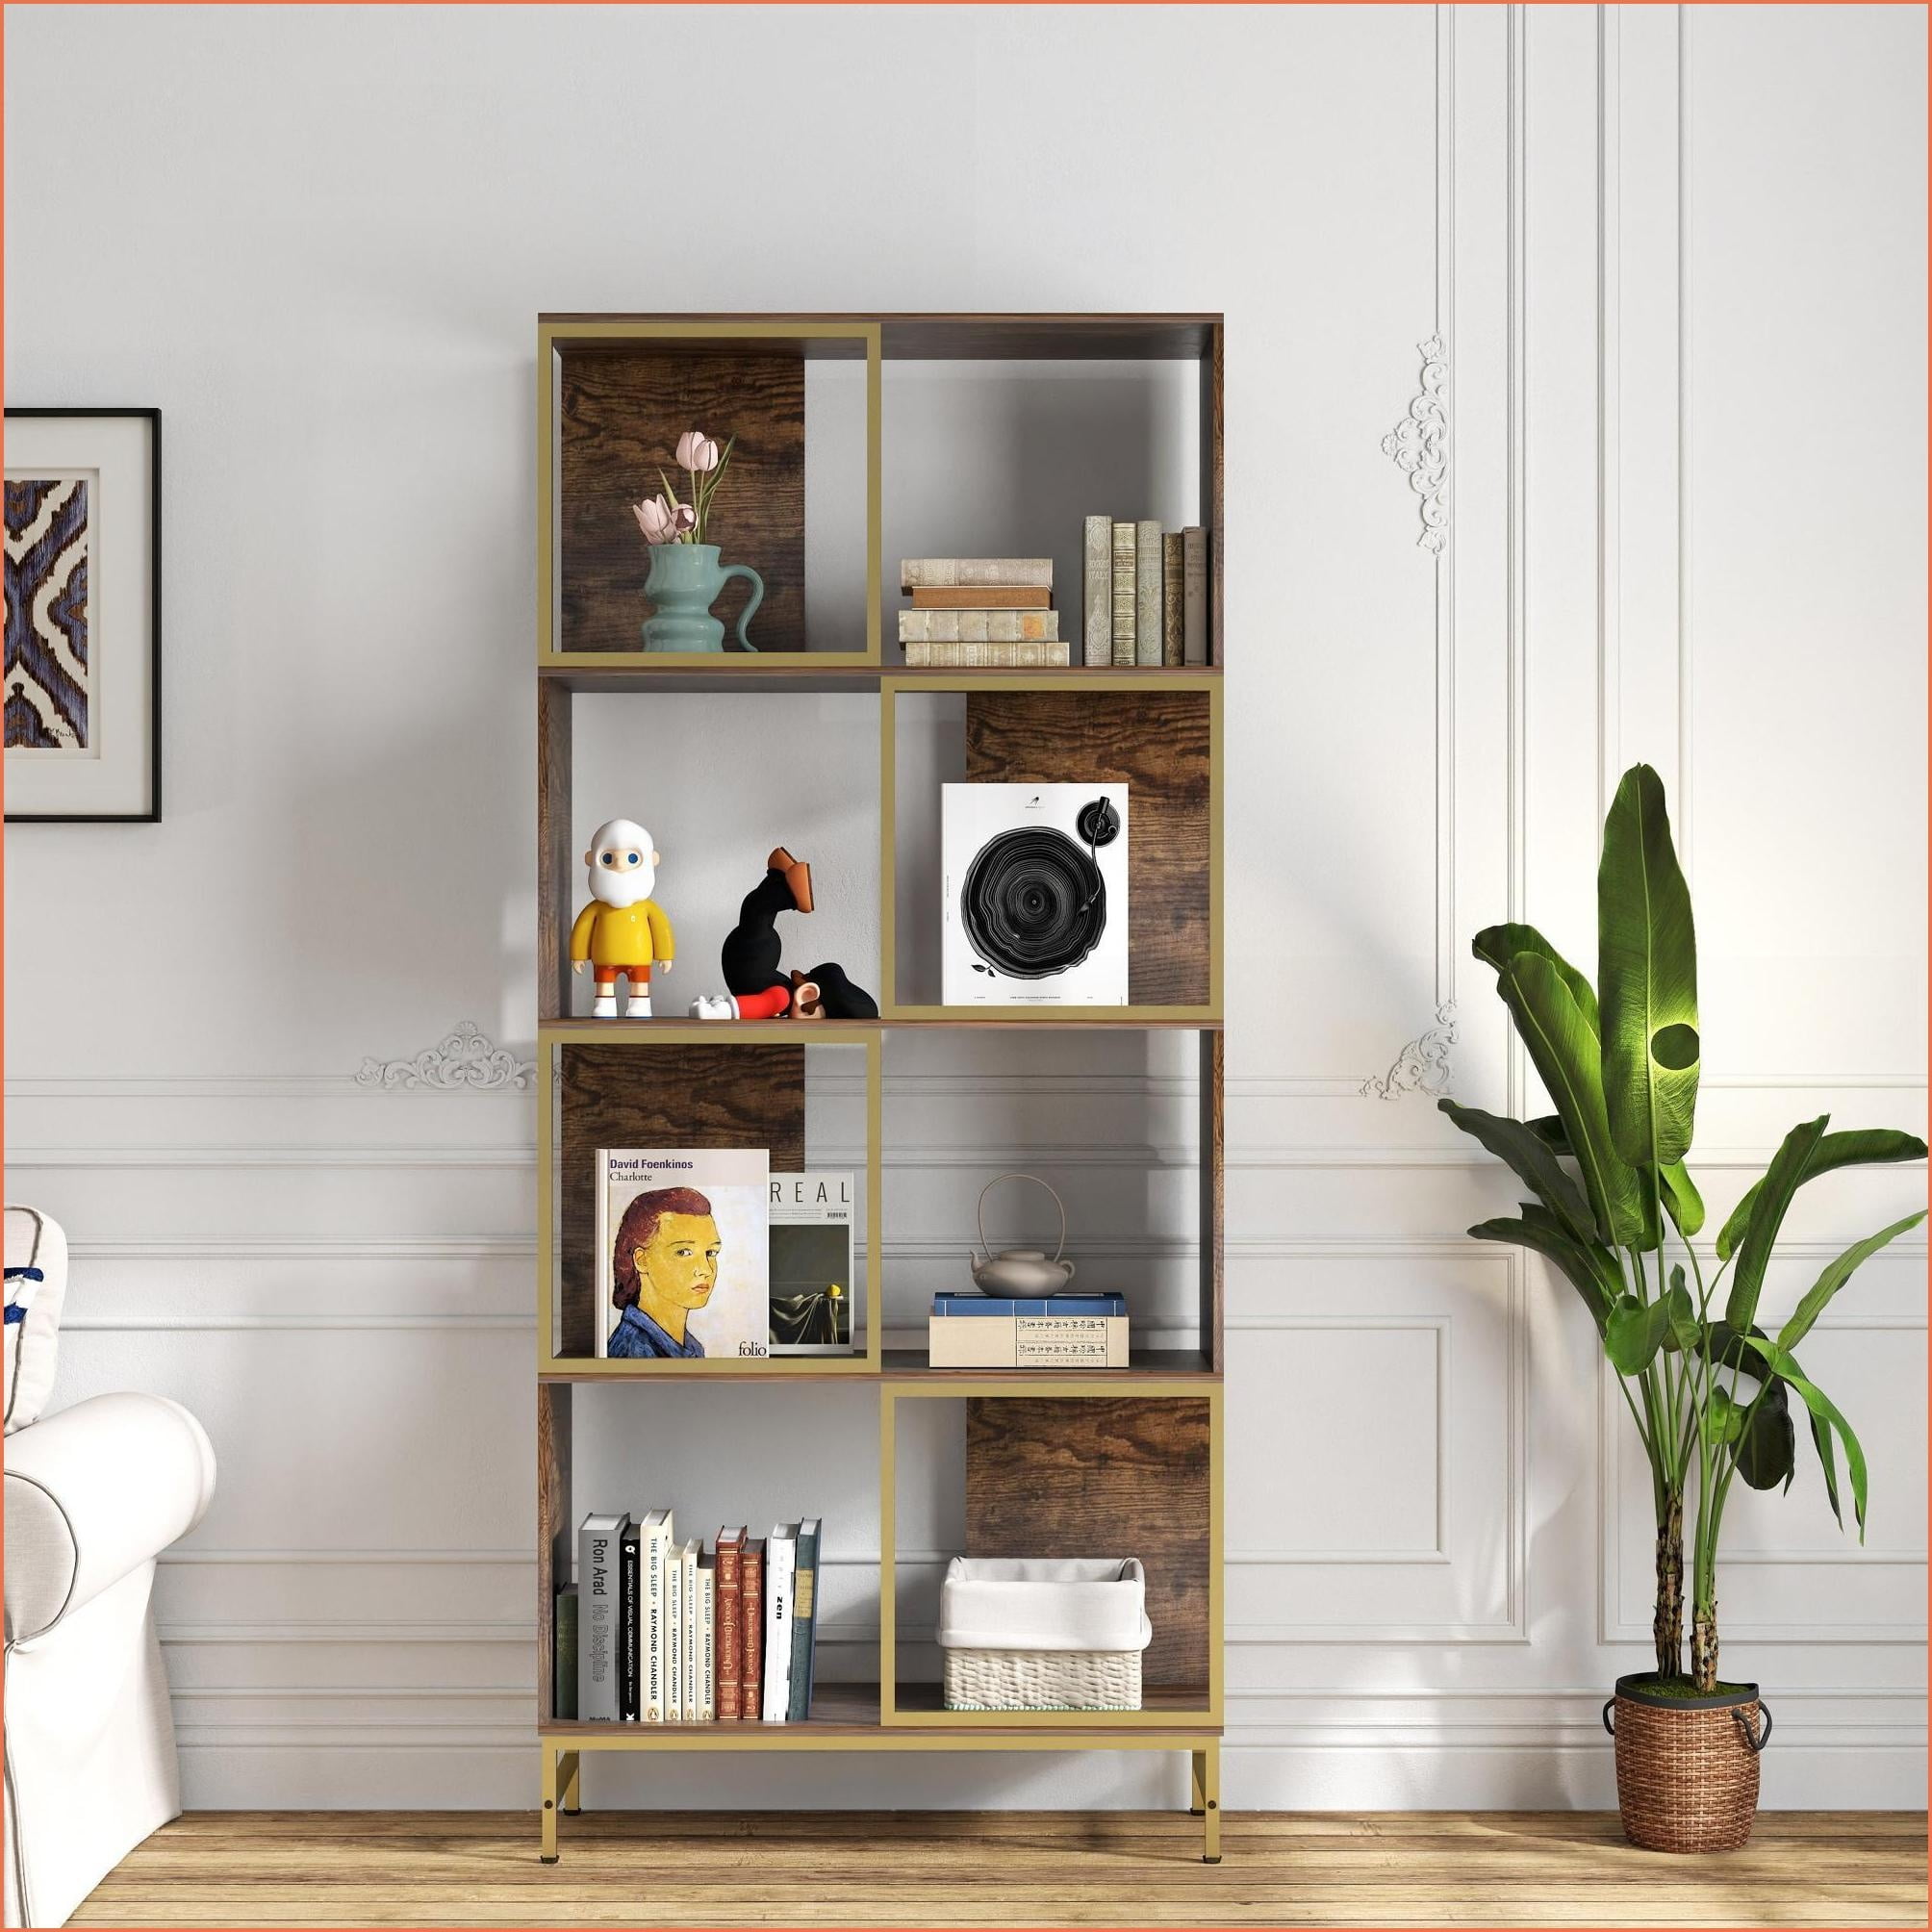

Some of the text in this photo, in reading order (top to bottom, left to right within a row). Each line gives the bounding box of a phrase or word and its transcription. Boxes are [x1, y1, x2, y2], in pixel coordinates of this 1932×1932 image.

[610, 1158, 694, 1169] David Foenkinos
[609, 1171, 652, 1182] Charlotte
[739, 1341, 767, 1357] folio
[627, 1595, 634, 1604] OF
[590, 1539, 608, 1683] Ron Arad No Discipline
